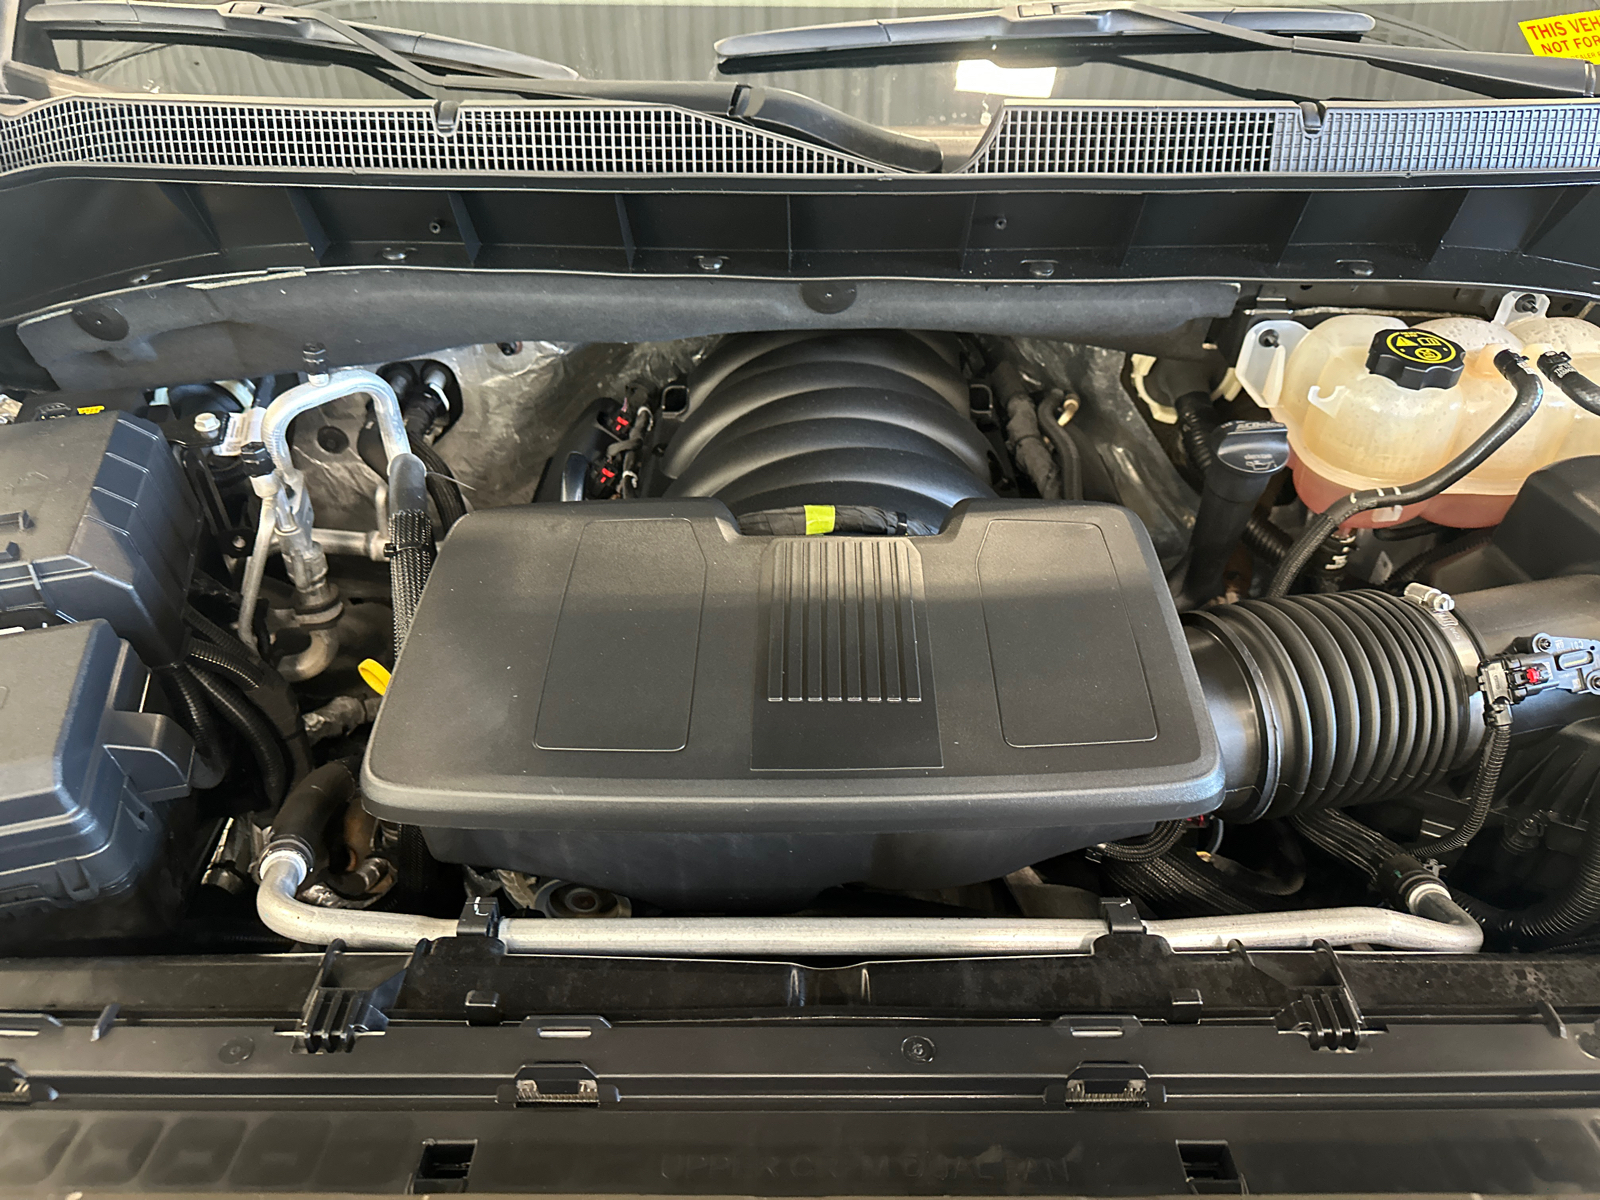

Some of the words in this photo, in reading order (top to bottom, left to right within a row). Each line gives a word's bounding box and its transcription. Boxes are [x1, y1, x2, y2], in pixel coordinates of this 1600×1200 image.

[1526, 21, 1567, 40] THIS
[1567, 15, 1600, 33] VEH
[1540, 40, 1570, 55] NOT
[1573, 35, 1600, 49] FOR
